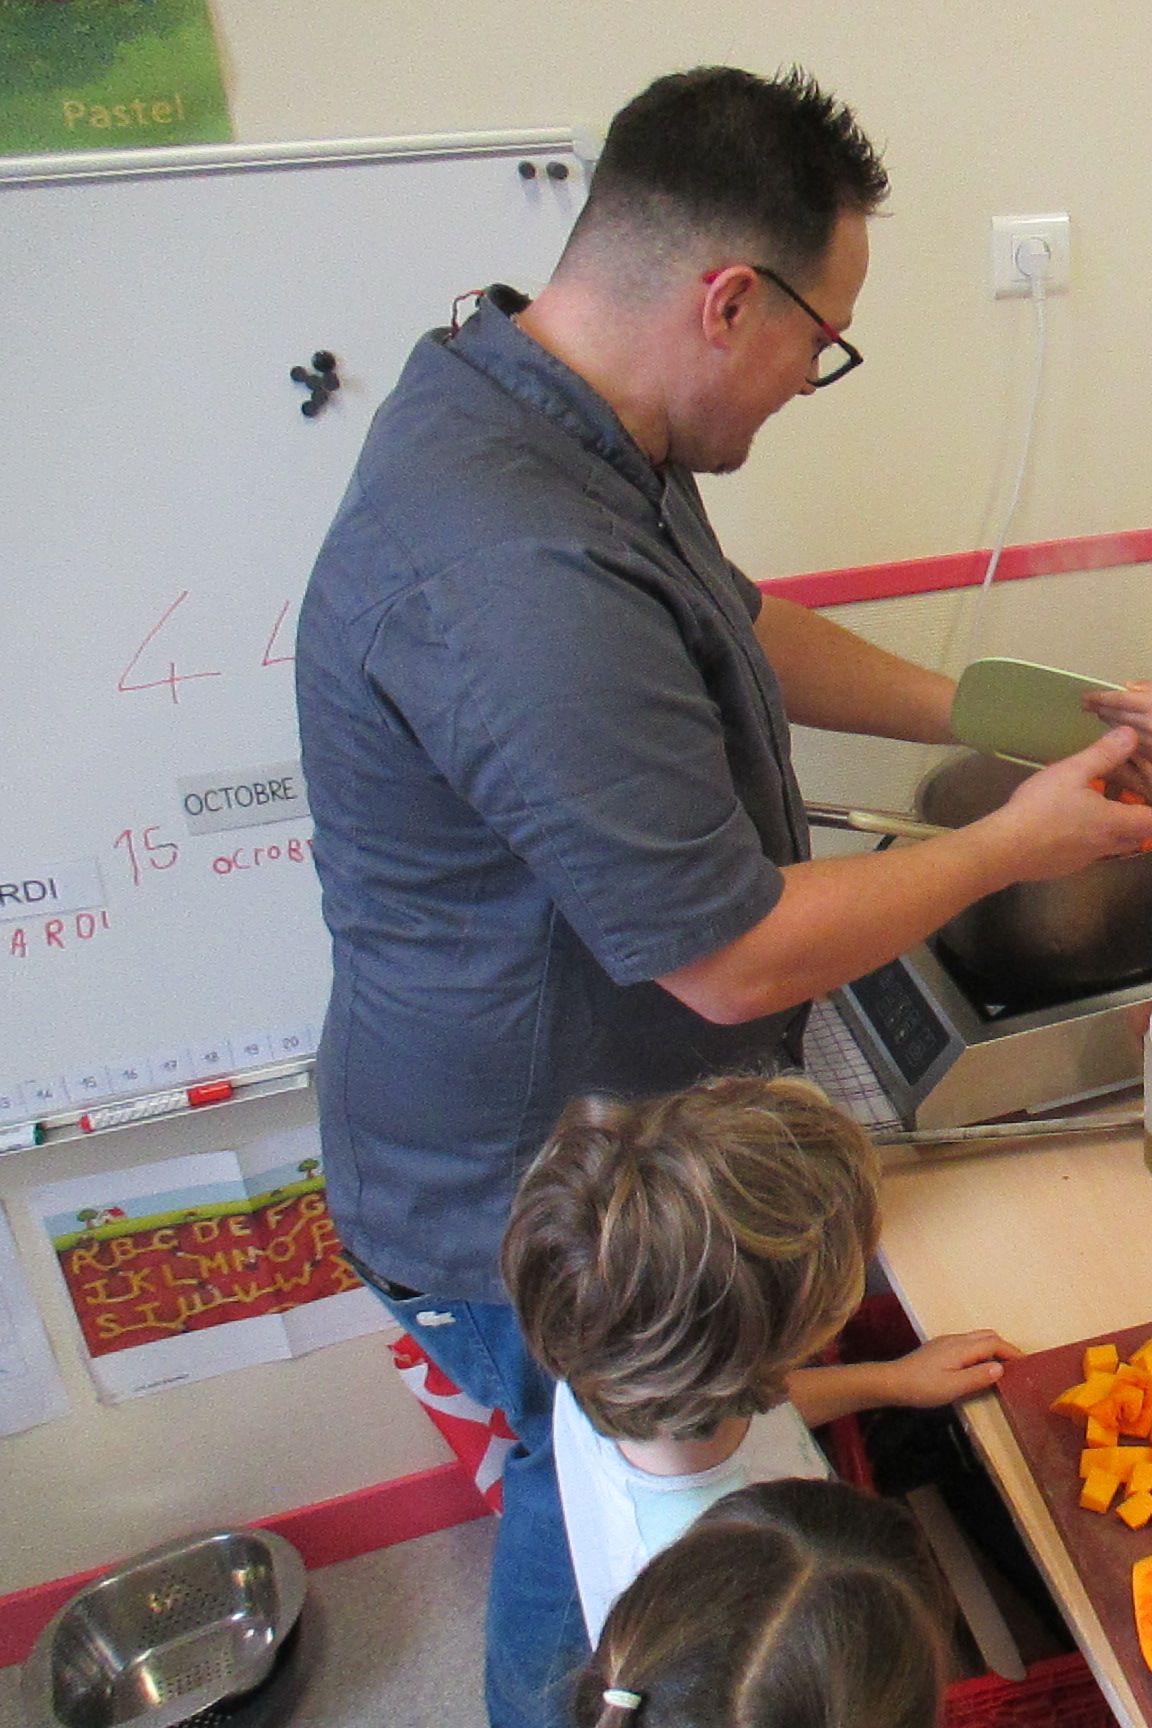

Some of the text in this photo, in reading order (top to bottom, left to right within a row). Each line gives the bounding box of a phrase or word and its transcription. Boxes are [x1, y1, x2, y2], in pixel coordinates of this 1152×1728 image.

[62, 92, 186, 130] Pastel
[117, 590, 222, 704] 4
[184, 777, 298, 816] OCTOBRE
[113, 826, 314, 886] 15 OCTOB
